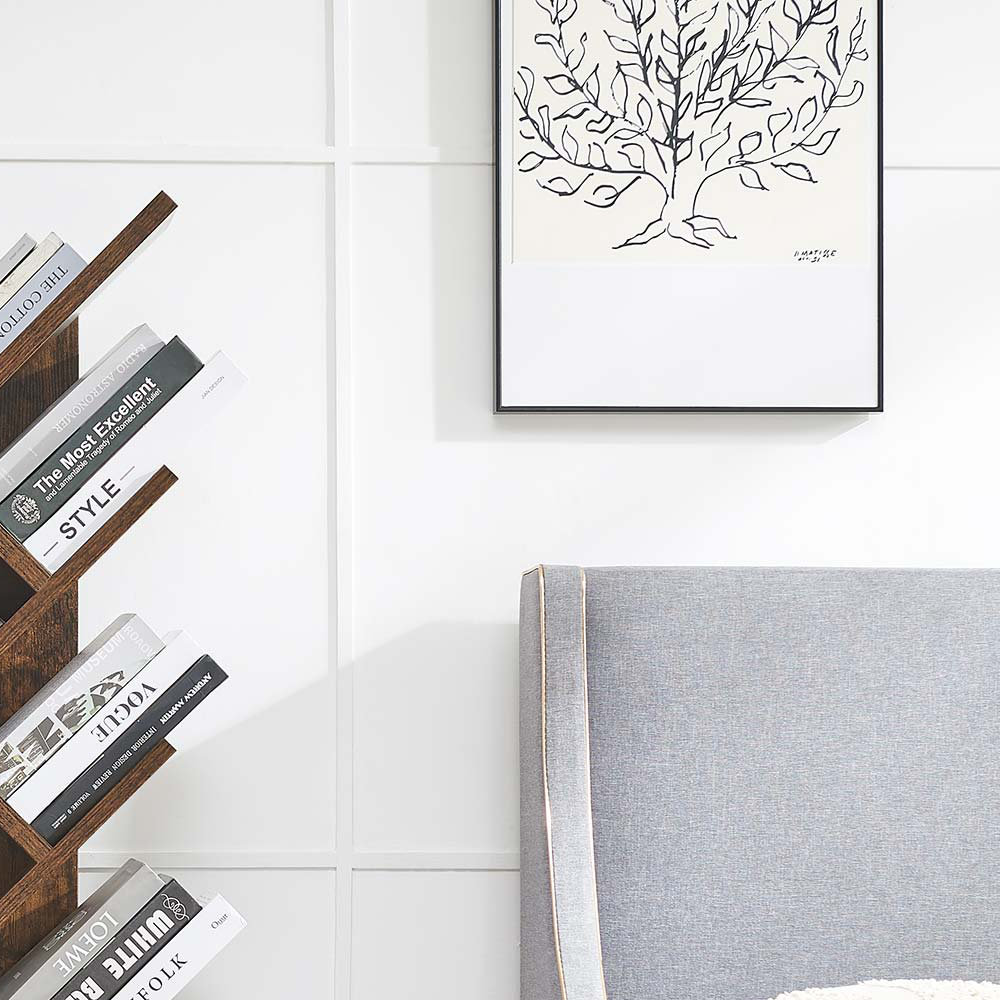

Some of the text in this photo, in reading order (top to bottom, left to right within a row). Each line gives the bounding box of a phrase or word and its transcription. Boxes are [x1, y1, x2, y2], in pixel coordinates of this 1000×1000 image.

[39, 266, 68, 292] THE
[32, 468, 62, 493] The
[59, 434, 97, 469] Most
[92, 376, 156, 441] Excellent
[45, 387, 162, 501] and Lamentable Tragedy of Romeo and Juliet
[59, 478, 121, 539] STYLE
[90, 682, 156, 742] VOGUE
[183, 672, 211, 701] ANDREW
[111, 749, 132, 770] DESIGN
[130, 726, 156, 751] INTERIOR
[91, 769, 112, 789] REVIEW
[52, 910, 118, 977] LOEWE
[101, 909, 175, 980] WHITE
